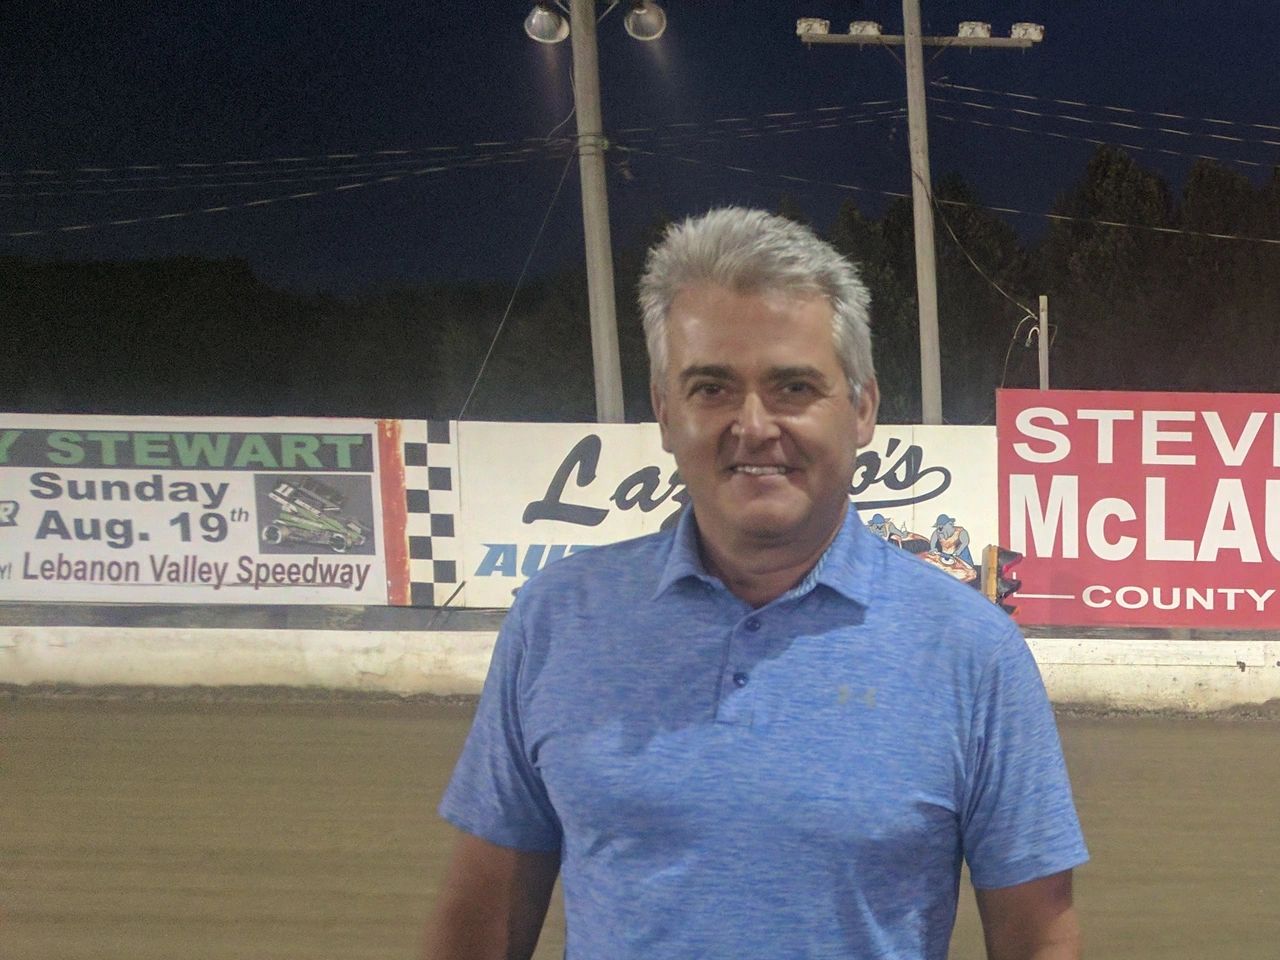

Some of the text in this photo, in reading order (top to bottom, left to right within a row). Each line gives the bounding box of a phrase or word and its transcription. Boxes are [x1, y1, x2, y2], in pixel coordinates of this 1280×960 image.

[47, 431, 364, 469] STEWART
[29, 471, 230, 509] Sunday
[35, 506, 250, 549] Aug. 19th
[22, 551, 140, 582] Lebanon
[149, 554, 228, 591] Valley
[236, 556, 371, 591] Speedway
[474, 543, 602, 577] AU
[1082, 585, 1276, 611] COUNTY
